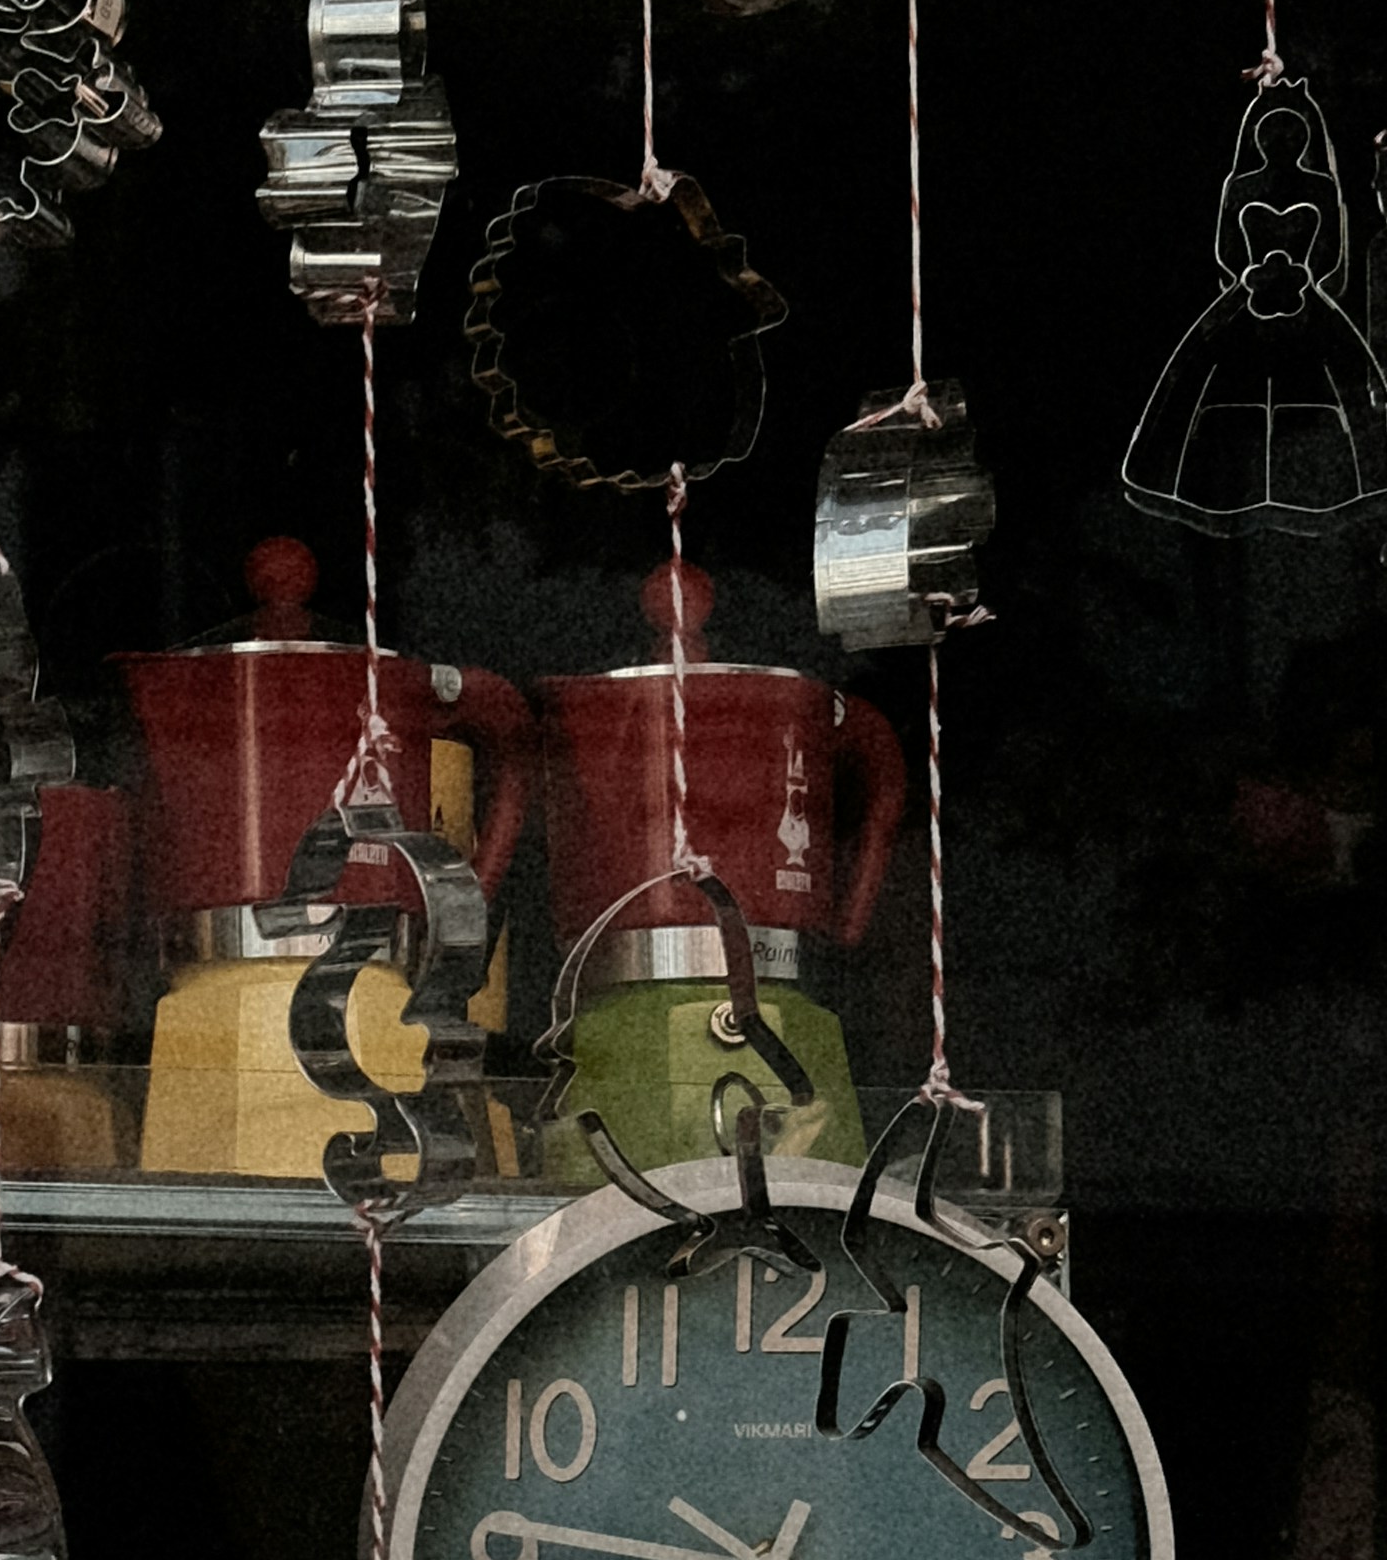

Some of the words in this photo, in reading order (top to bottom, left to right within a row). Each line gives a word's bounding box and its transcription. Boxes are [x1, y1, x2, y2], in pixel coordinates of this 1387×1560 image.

[623, 1285, 678, 1387] 11
[734, 1253, 827, 1354] 12
[904, 1285, 921, 1381] 1
[505, 1377, 597, 1483] 10
[733, 1423, 813, 1439] VIKMARI
[966, 1377, 1032, 1482] 2
